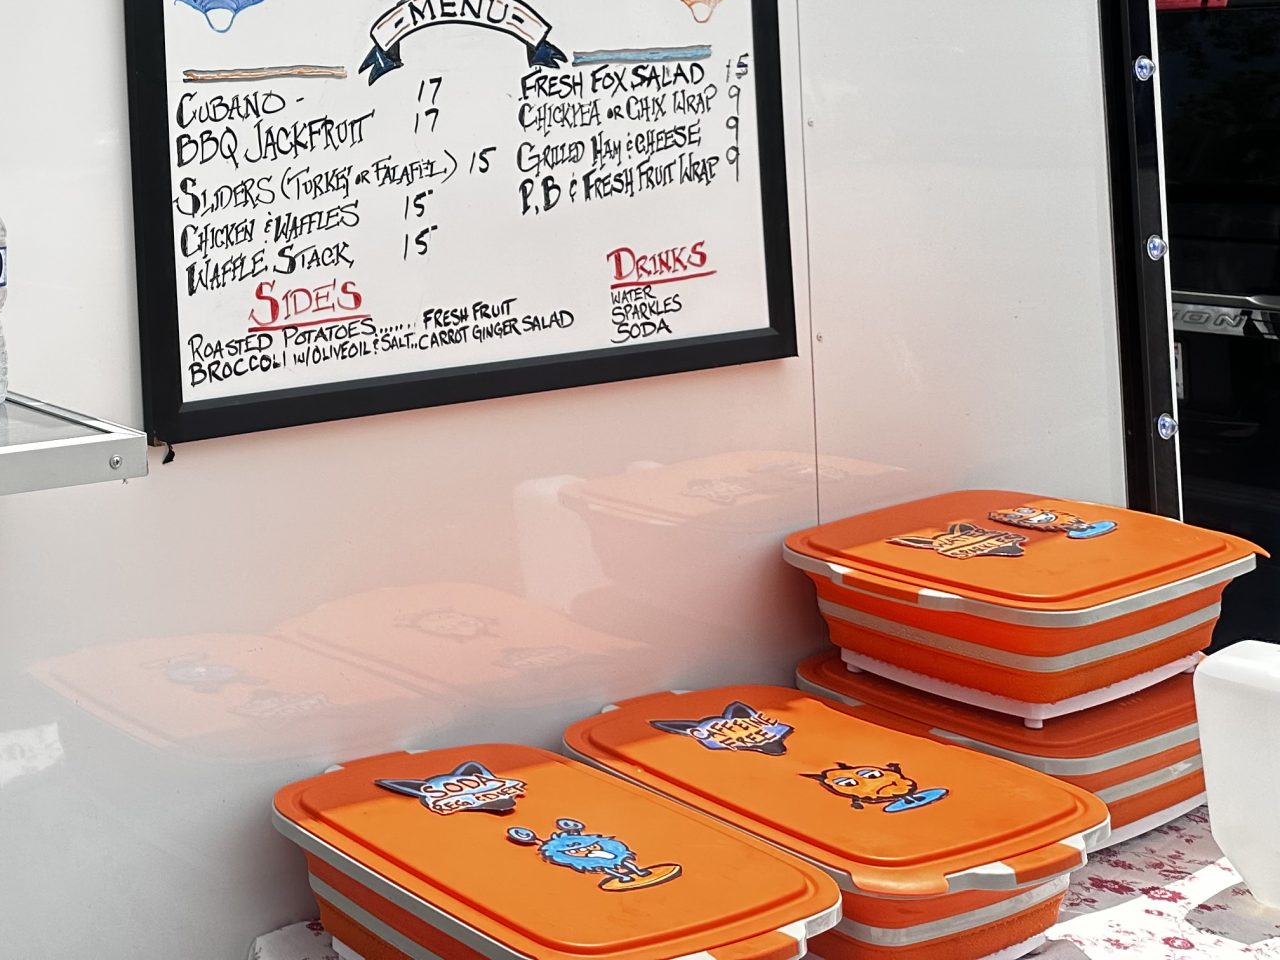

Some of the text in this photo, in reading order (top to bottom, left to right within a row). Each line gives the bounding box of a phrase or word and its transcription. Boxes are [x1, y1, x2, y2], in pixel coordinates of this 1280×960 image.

[176, 77, 442, 129] CUBANO 17
[518, 66, 583, 101] FRESH
[591, 64, 628, 97] FOX
[630, 62, 705, 91] SALAD
[518, 98, 602, 137] CHICKPEA
[626, 93, 667, 123] CHIX
[672, 84, 718, 115] WRAP
[728, 85, 741, 116] 9
[176, 108, 439, 169] BBQ JACKFRUIT 17
[517, 140, 585, 178] GRILLED
[590, 130, 622, 171] HAM
[634, 118, 702, 155] CHEESE
[726, 116, 739, 145] 9
[173, 176, 275, 218] SLIDERS
[281, 164, 353, 200] (TURKEY
[469, 146, 497, 175] 15
[583, 167, 635, 202] FRESH
[636, 155, 677, 191] FRUIT
[679, 151, 721, 186] WRAP
[726, 145, 740, 183] 9
[180, 218, 256, 259] CHICKEN
[274, 200, 360, 244] WAFFLES
[404, 189, 434, 220] 15
[186, 225, 438, 297] WAFFLE STACK 15
[607, 240, 708, 282] DRINKS
[248, 278, 362, 327] SIDES
[610, 284, 657, 306] WATER
[611, 293, 682, 325] SPARKLES
[187, 333, 274, 362] ROASTED
[423, 306, 470, 330] FRESH
[472, 298, 518, 321] FRUIT
[188, 351, 287, 387] BROCCOLI
[419, 325, 471, 350] CARROT
[472, 318, 522, 342] GINGER
[521, 310, 574, 332] SALAD
[610, 318, 673, 344] SODA
[689, 713, 779, 740] CAFFEINE
[718, 729, 777, 750] FREE
[422, 774, 506, 799] SODA
